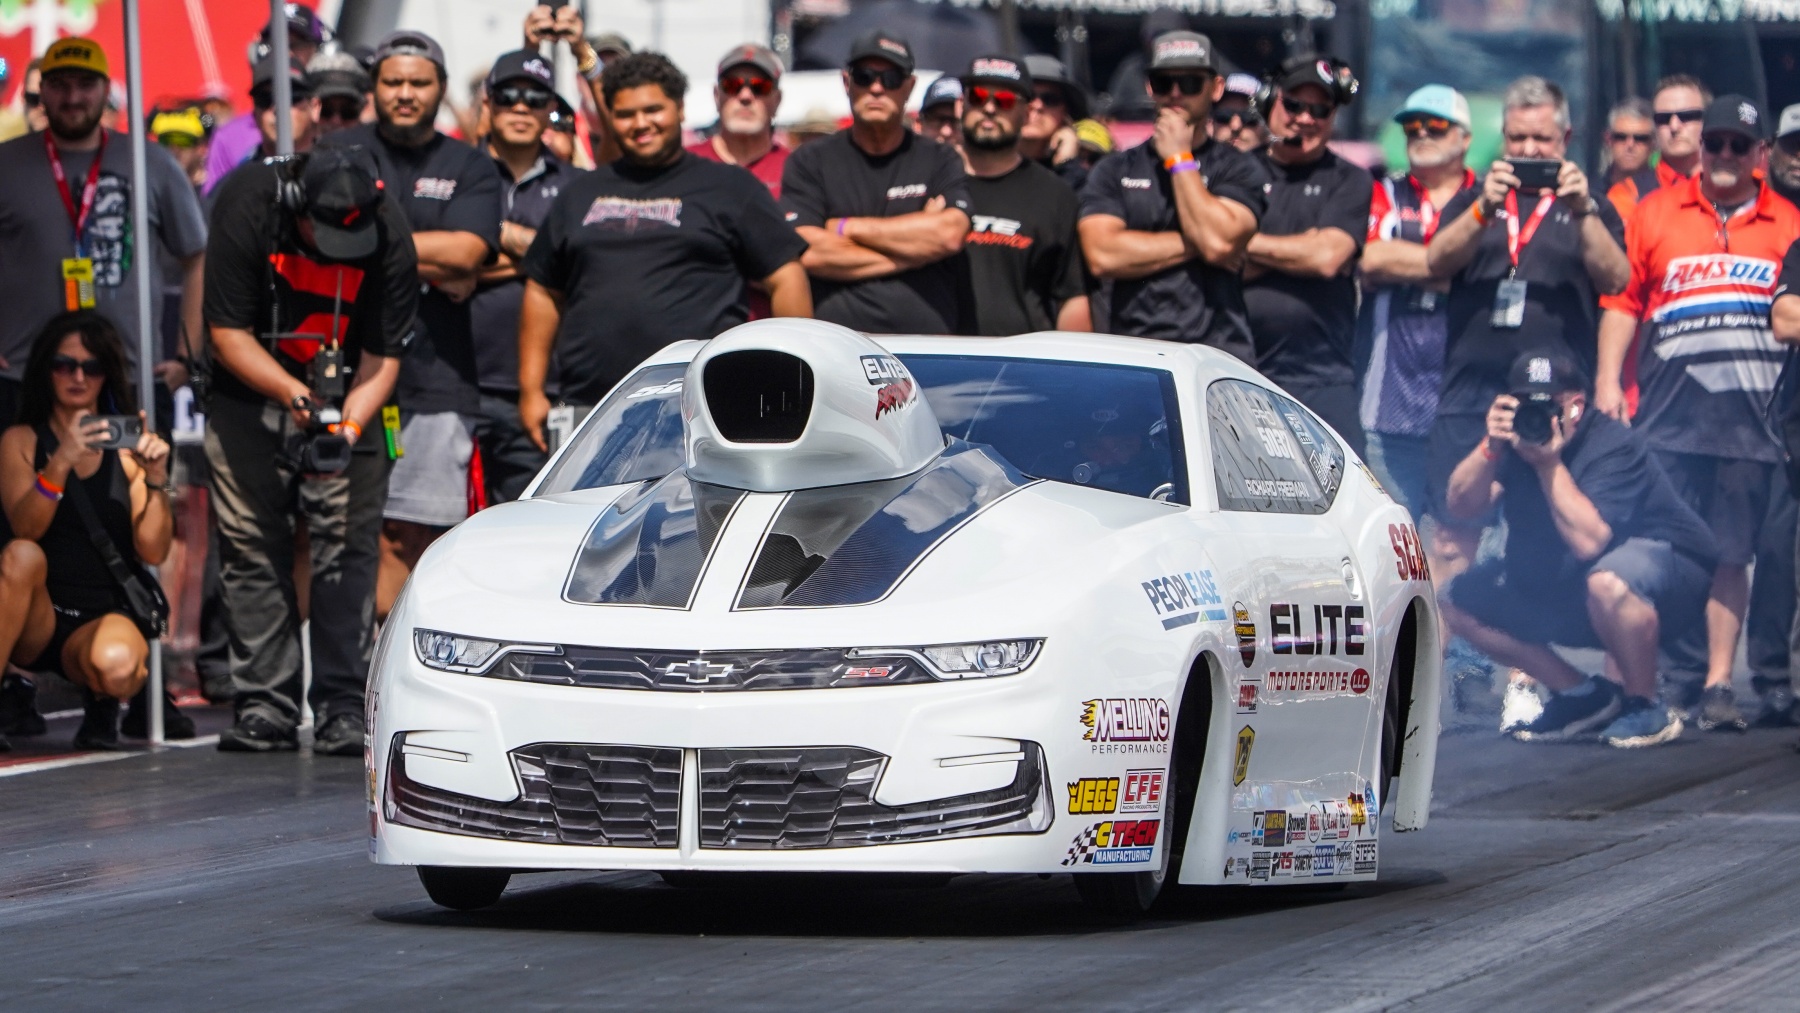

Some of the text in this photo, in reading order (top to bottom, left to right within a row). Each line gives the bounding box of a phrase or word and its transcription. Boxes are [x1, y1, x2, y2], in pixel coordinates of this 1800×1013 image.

[1670, 261, 1771, 284] AMSOIL
[861, 358, 908, 380] ELITE
[1251, 408, 1276, 426] PRO
[1245, 479, 1310, 498] RICHARD FREEMAN
[1388, 523, 1429, 580] SCA
[1141, 570, 1222, 615] PEOPLEASE
[1270, 604, 1365, 656] ELITE
[842, 667, 893, 678] SS
[1352, 674, 1367, 688] LLC
[1091, 698, 1170, 742] MELLING
[1091, 744, 1168, 754] PERFORMANCE
[1068, 777, 1120, 815] JEGS
[1124, 773, 1163, 803] CFE
[1310, 814, 1319, 831] BELL
[1095, 849, 1151, 864] MANUFACTURING
